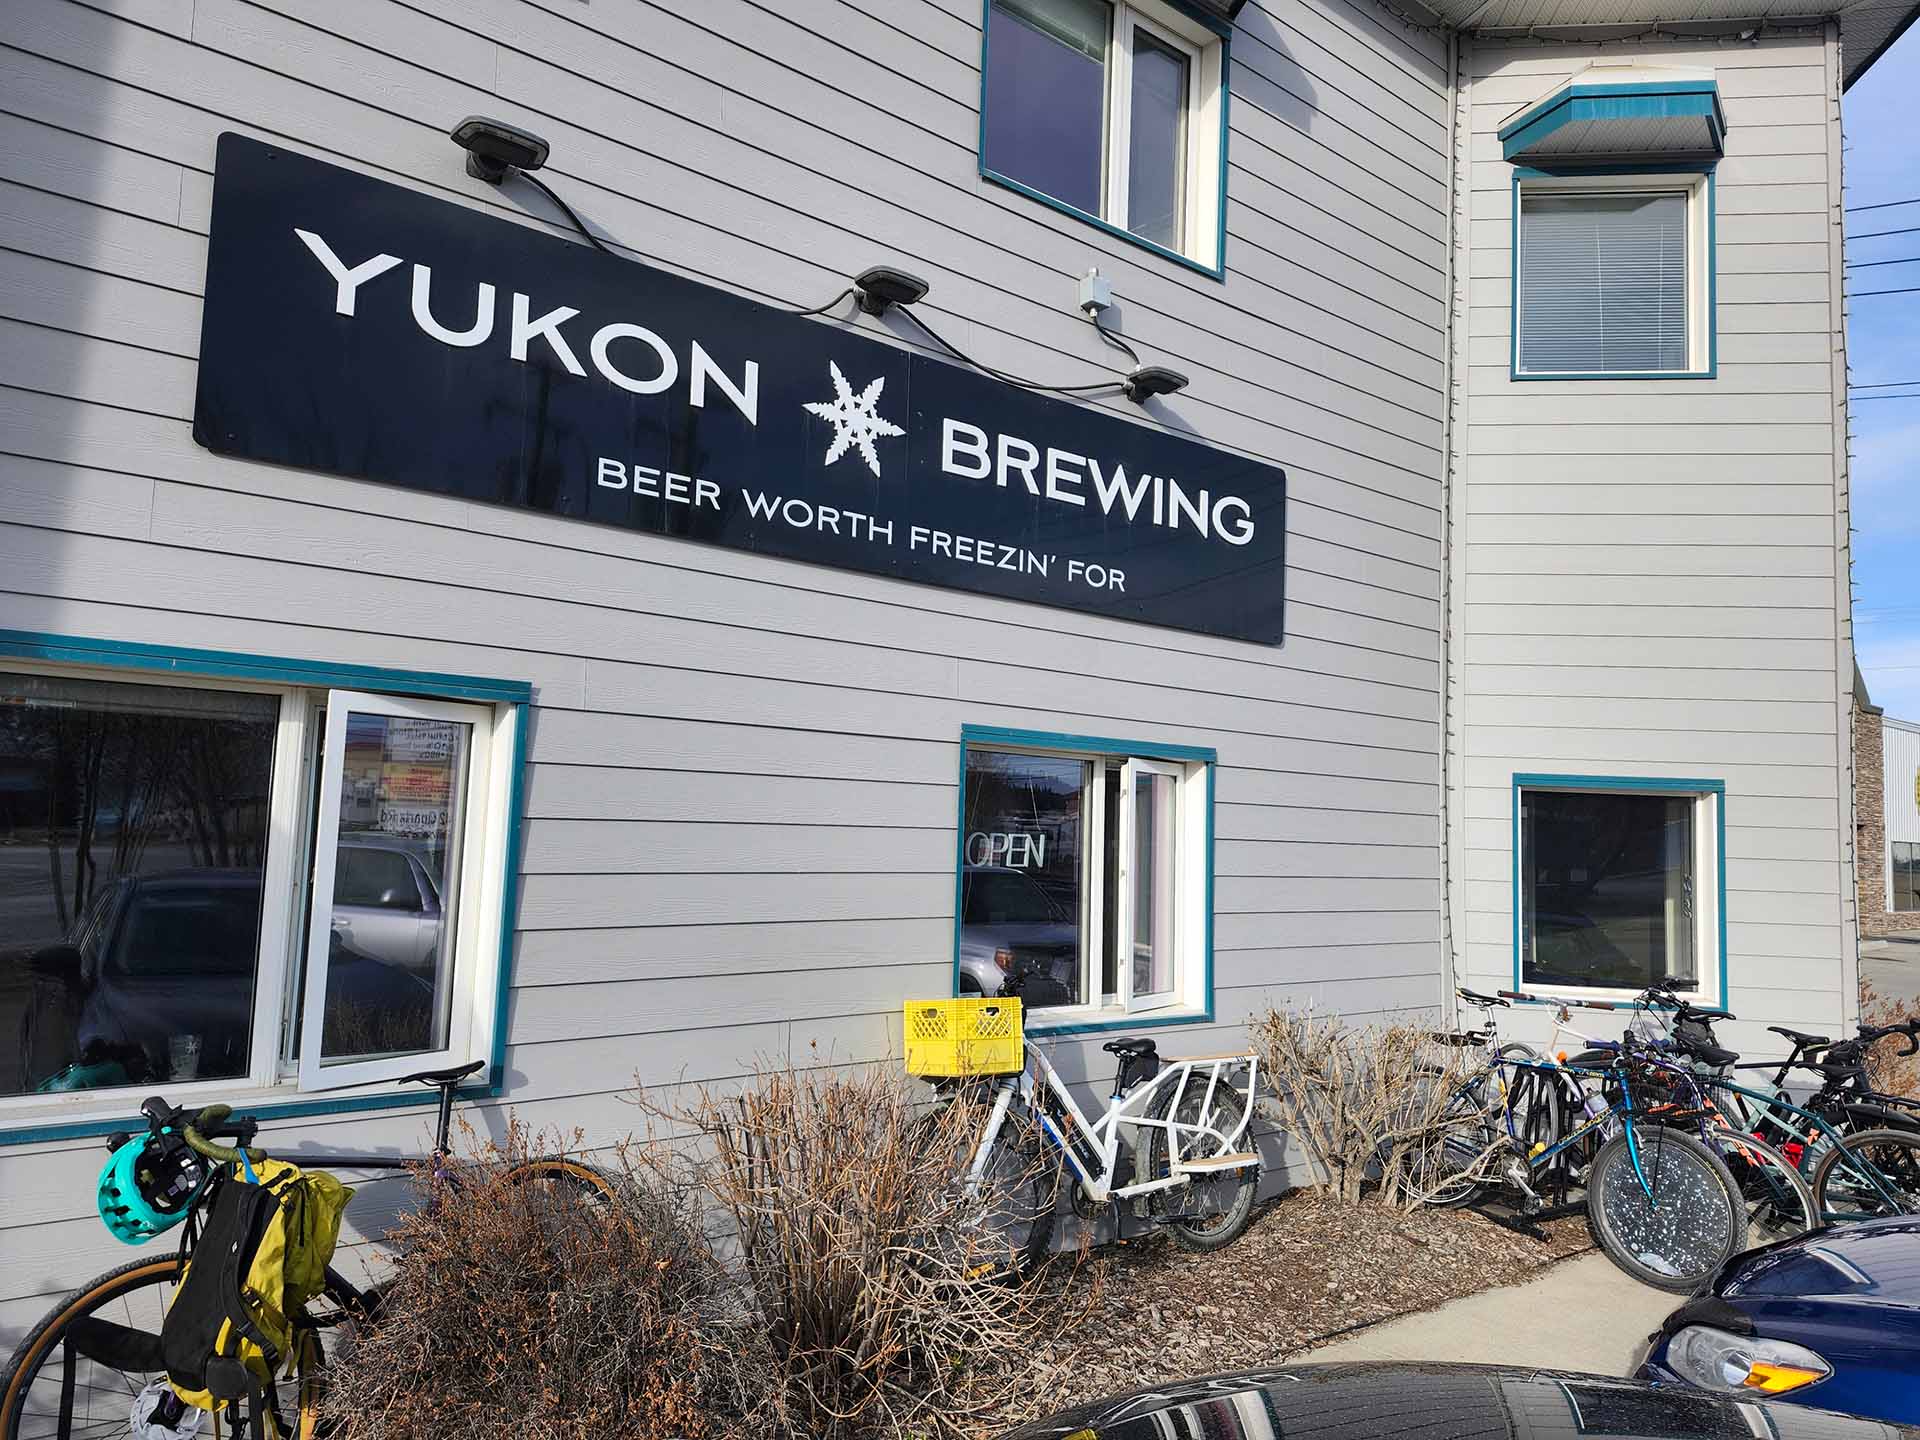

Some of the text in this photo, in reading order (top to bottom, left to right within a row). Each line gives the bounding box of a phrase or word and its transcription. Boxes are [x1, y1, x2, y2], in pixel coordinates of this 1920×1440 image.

[294, 228, 1256, 546] YUKON BREWING
[597, 457, 1126, 592] BEER WORTH FREEZIN' FOR
[966, 831, 1046, 869] OPEN
